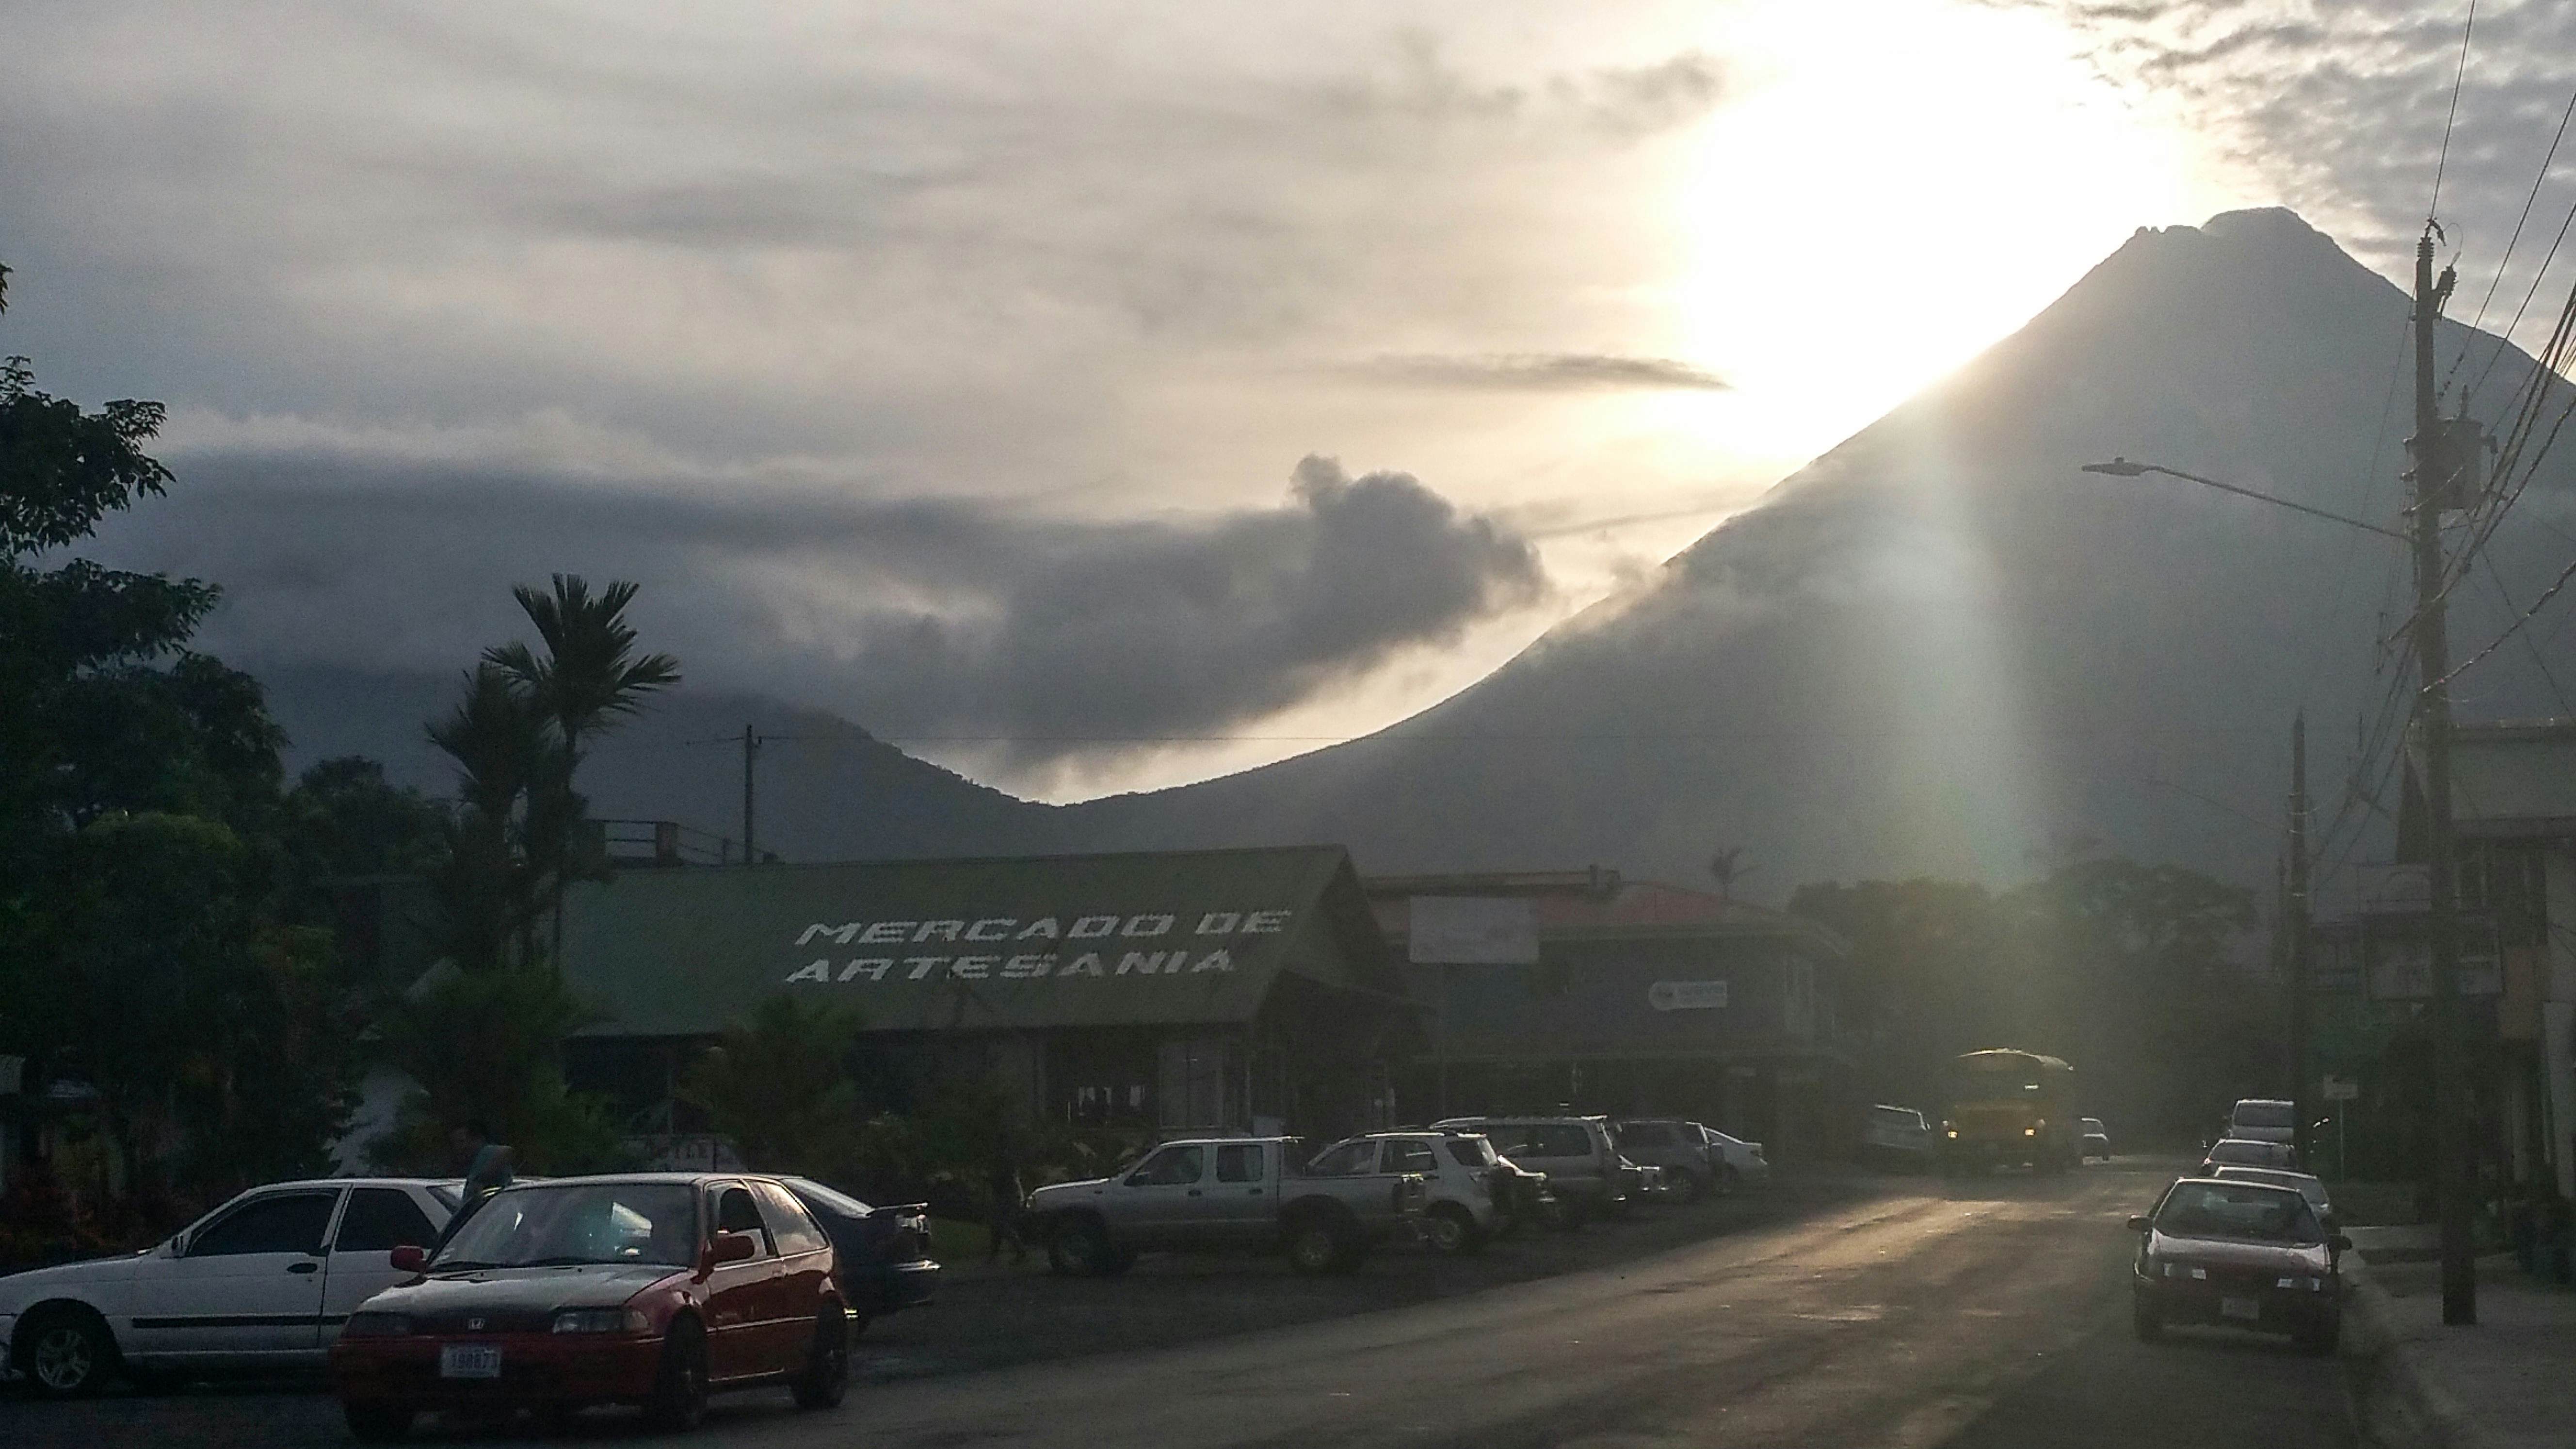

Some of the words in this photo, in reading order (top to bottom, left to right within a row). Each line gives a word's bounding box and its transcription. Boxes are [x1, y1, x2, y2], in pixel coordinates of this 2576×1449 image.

[794, 913, 1175, 945] MERCADO
[1193, 909, 1292, 935] DE
[784, 949, 1236, 983] ARTESANIA
